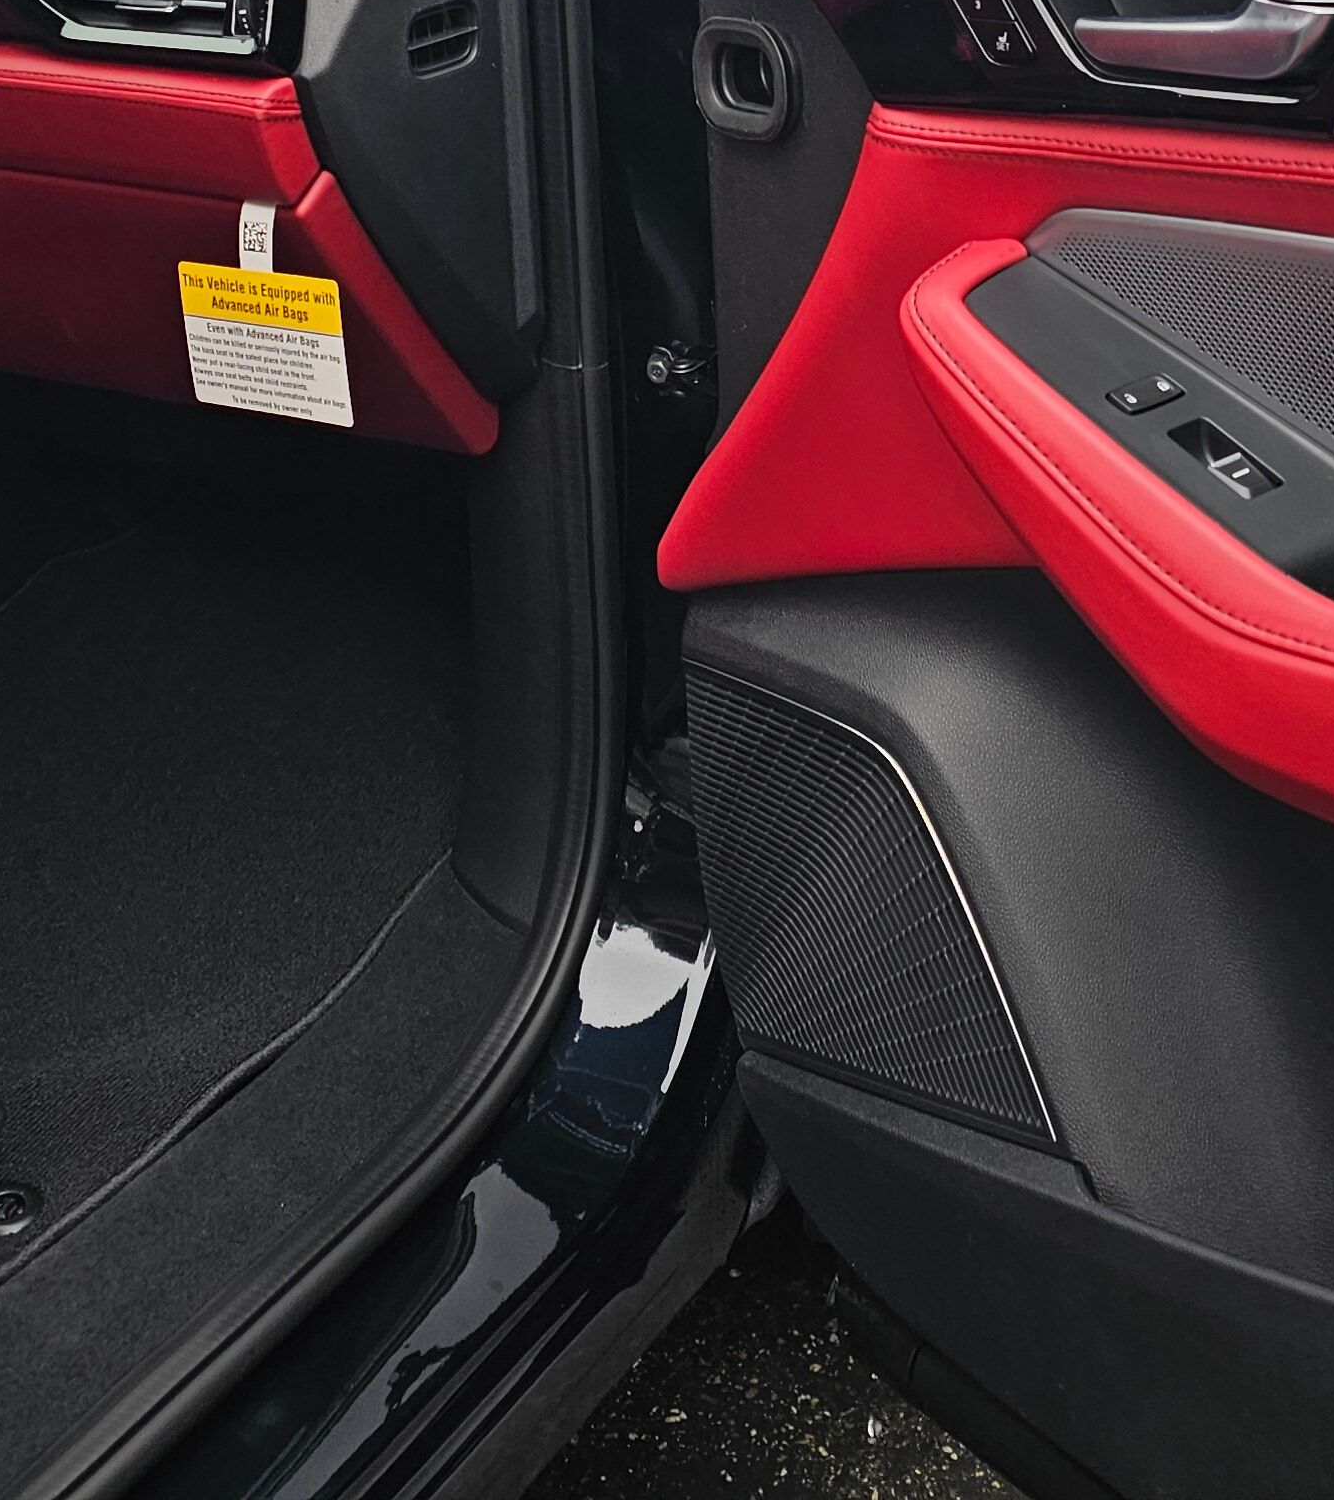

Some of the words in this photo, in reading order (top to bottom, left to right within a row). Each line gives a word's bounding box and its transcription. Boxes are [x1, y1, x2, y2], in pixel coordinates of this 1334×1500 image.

[974, 0, 982, 10] 3
[995, 41, 1010, 52] SET
[182, 273, 204, 287] This
[207, 275, 245, 293] Vehicle
[248, 281, 257, 294] is
[261, 283, 310, 303] Equipped
[313, 290, 336, 305] with
[212, 295, 261, 312] Advanced
[264, 302, 280, 316] Air
[282, 304, 309, 323] Bags
[207, 322, 225, 333] Even
[227, 325, 244, 335] with
[246, 327, 283, 340] Advanced
[286, 333, 298, 343] Air
[300, 335, 320, 348] Bags
